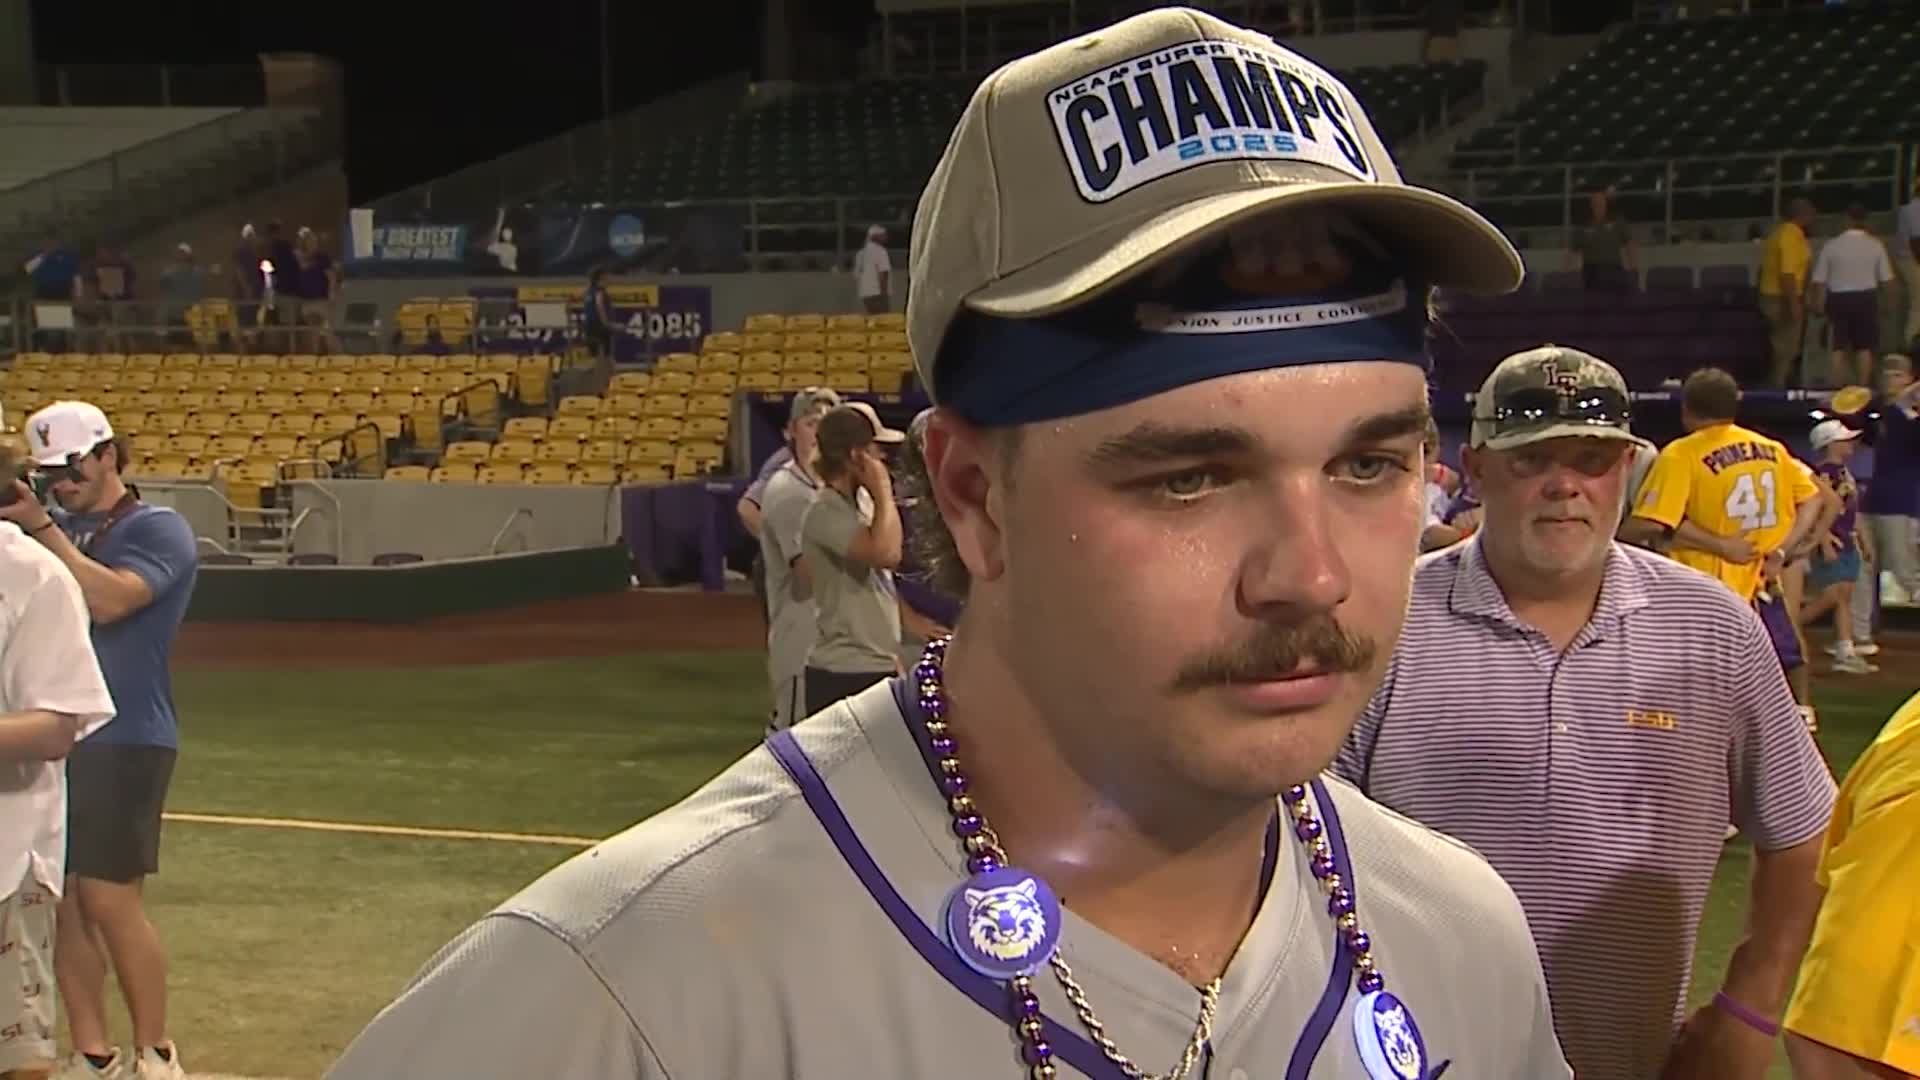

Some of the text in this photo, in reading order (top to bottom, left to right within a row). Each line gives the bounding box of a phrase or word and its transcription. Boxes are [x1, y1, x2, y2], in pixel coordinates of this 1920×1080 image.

[1137, 43, 1226, 72] SUPER
[1065, 56, 1369, 192] CHAMPS
[1177, 134, 1298, 161] 2025
[1232, 312, 1303, 327] JUSTICE
[1726, 471, 1777, 530] 41
